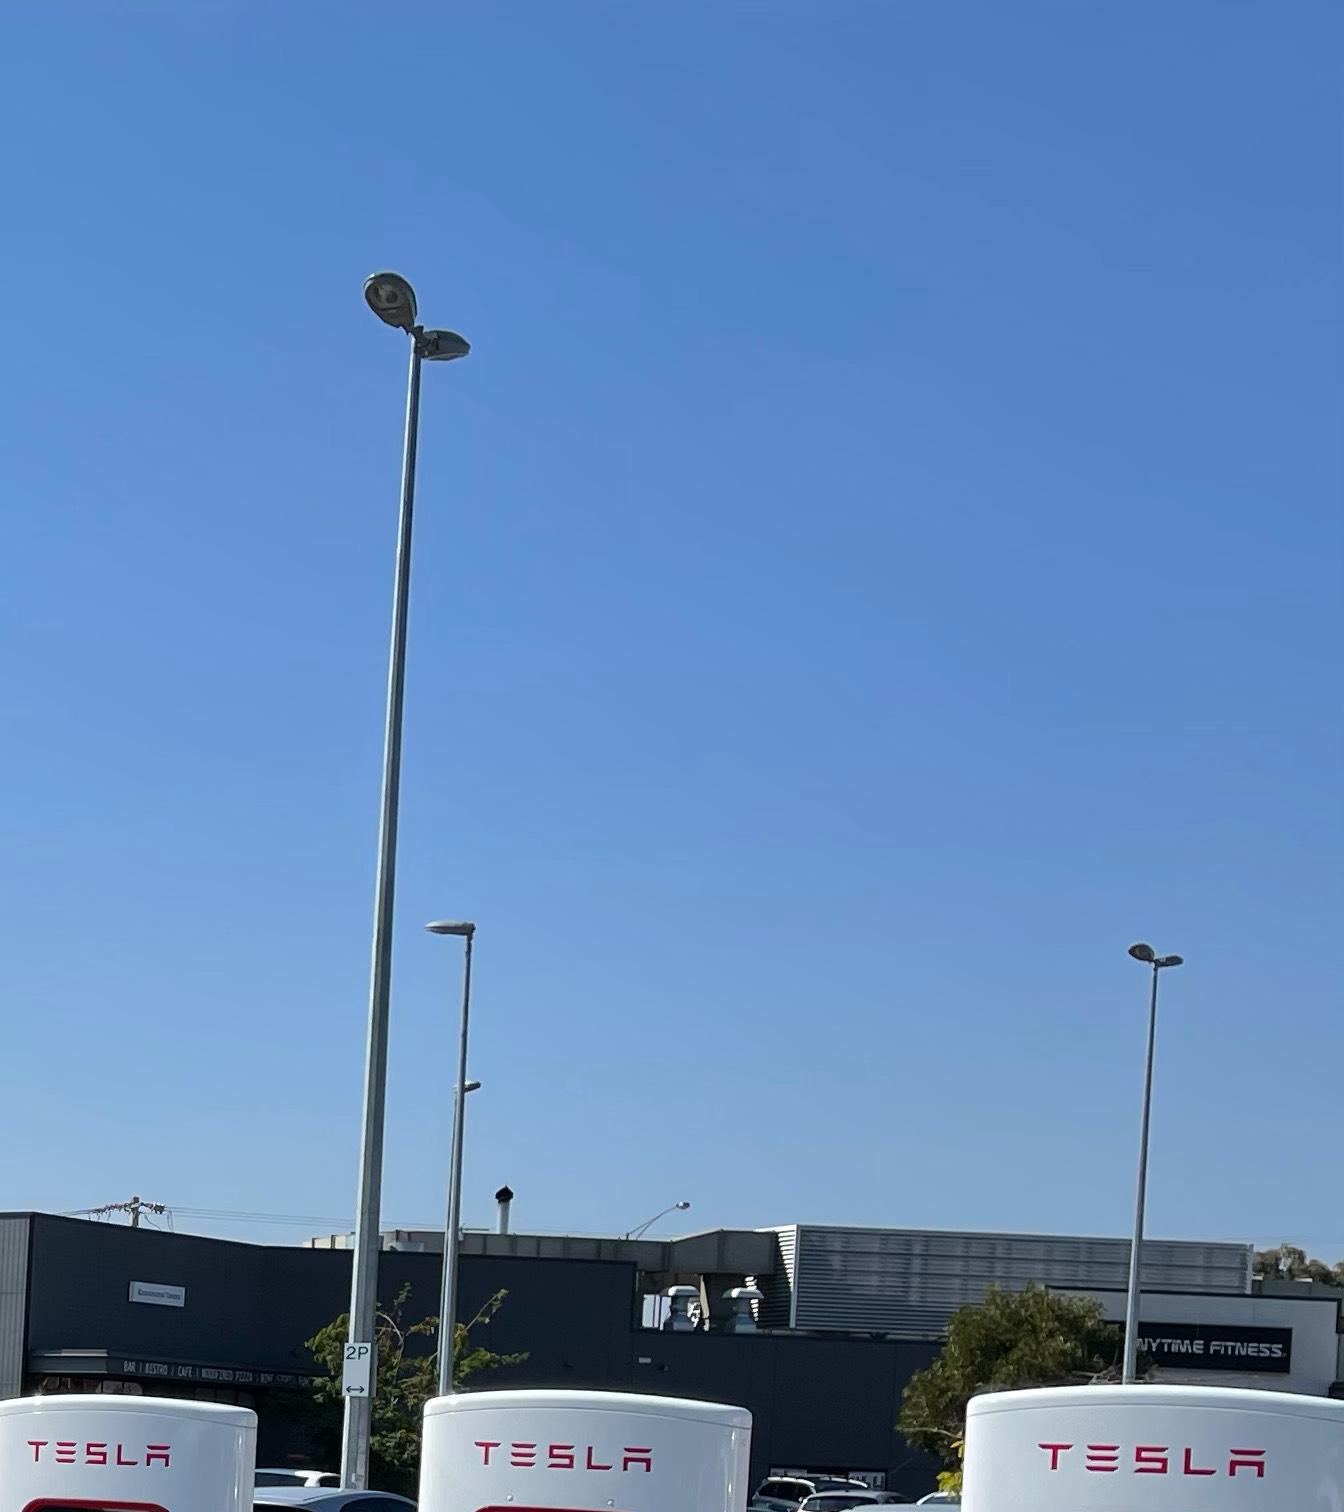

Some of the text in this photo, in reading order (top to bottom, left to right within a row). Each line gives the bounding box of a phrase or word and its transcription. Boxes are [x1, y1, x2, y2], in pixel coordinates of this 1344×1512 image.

[346, 1346, 369, 1360] 2P
[1136, 1338, 1204, 1354] NYTIME
[123, 1361, 136, 1373] BAR
[27, 1440, 172, 1469] TESLA
[474, 1440, 653, 1473] TESLA
[1038, 1442, 1267, 1478] TESLA
